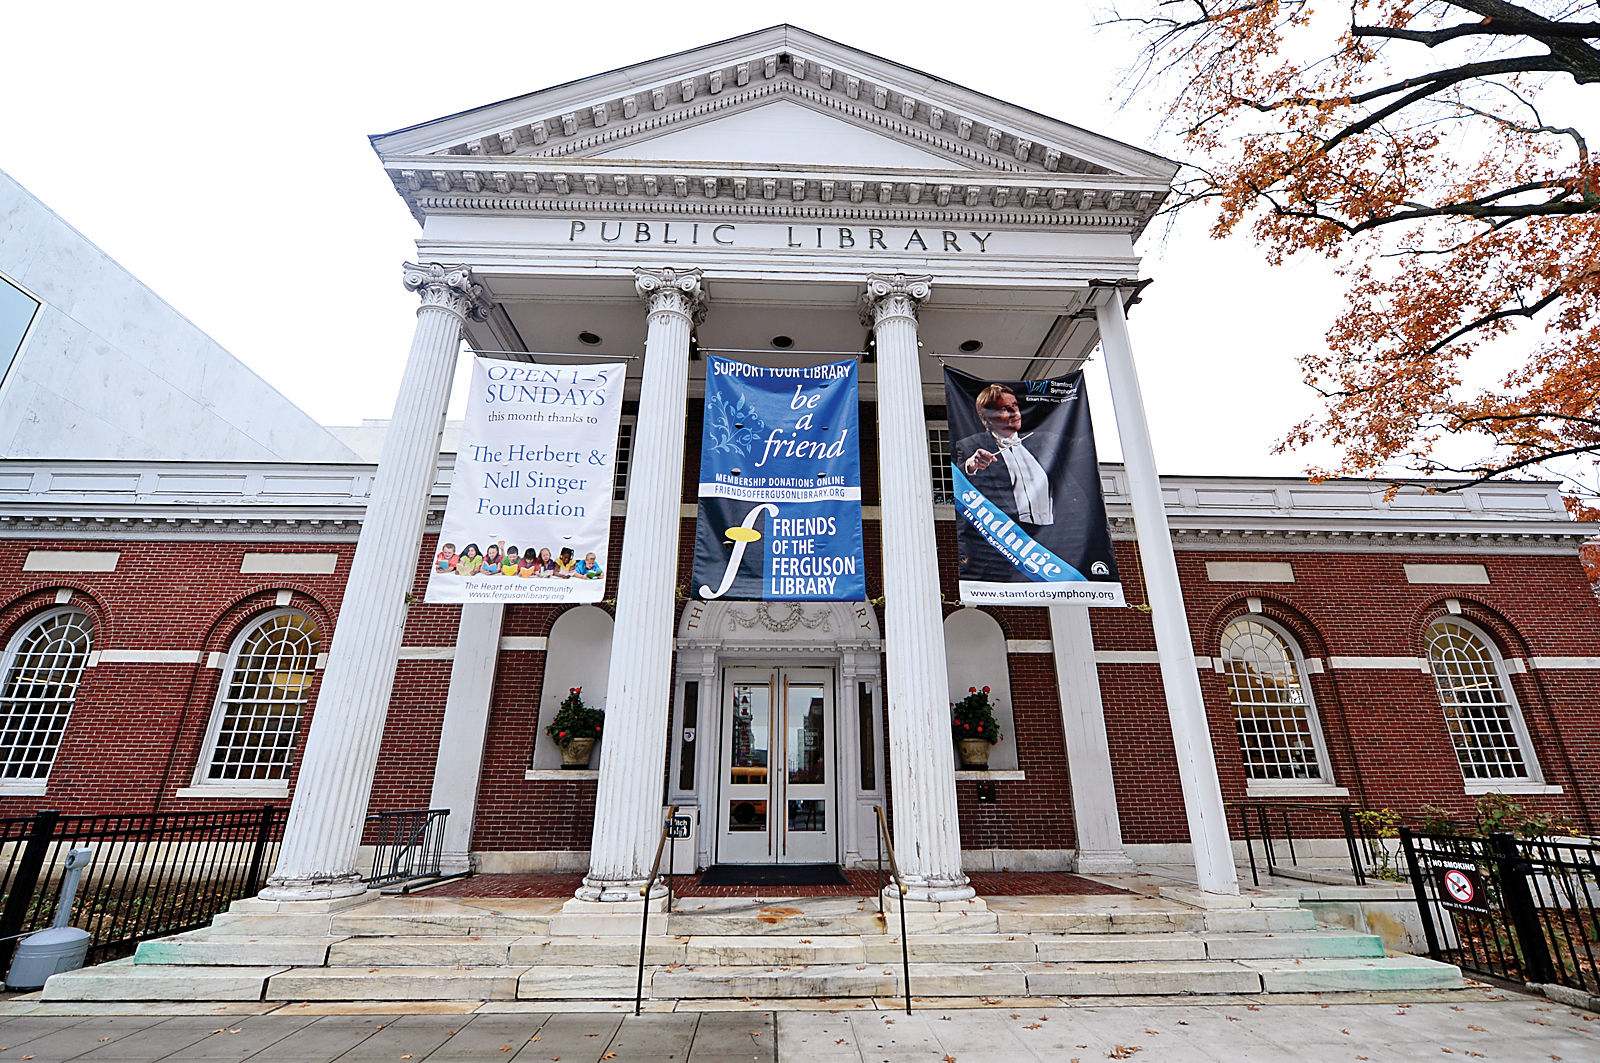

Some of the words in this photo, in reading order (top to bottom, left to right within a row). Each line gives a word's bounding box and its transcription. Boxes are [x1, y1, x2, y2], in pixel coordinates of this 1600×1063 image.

[570, 219, 736, 246] PUBLIC
[788, 226, 992, 253] LIBRARY
[488, 366, 561, 383] OPEN
[714, 361, 764, 378] SUPPORT
[804, 364, 850, 379] LIBRARY
[1050, 380, 1073, 388] Stamford
[486, 384, 606, 406] SUNDAYS
[790, 385, 821, 410] be
[488, 411, 505, 422] this
[507, 411, 544, 422] month
[548, 412, 583, 424] thanks
[586, 414, 598, 424] to
[795, 413, 814, 430] a
[470, 444, 502, 463] The
[508, 444, 581, 463] Herbert
[588, 449, 607, 466] &
[754, 429, 848, 467] friend
[483, 470, 520, 489] Nell
[526, 470, 587, 495] Singer
[715, 473, 766, 487] MEMBERSHIP
[768, 477, 814, 488] DONATIONS
[816, 475, 845, 487] ONLINE
[714, 484, 845, 500] FRIENDSOFFERGUSONLIBRARY.ORG
[476, 497, 585, 518] Foundation
[773, 516, 836, 537] FRIENDS
[962, 490, 1061, 577] Indulge
[963, 508, 973, 520] in
[973, 520, 988, 536] the
[988, 535, 1020, 565] season
[772, 539, 788, 555] OF
[791, 539, 815, 555] THE
[772, 556, 856, 577] FERGUSON
[465, 582, 478, 590] The
[480, 582, 502, 591] Heart
[504, 583, 513, 591] of
[514, 584, 528, 592] the
[529, 584, 574, 594] Community
[771, 576, 837, 595] LIBRARY
[970, 589, 1114, 600] www.stamfordsymphony.org
[469, 591, 565, 601] www.fergusonlibrary.org
[1443, 860, 1476, 871] SMOKING
